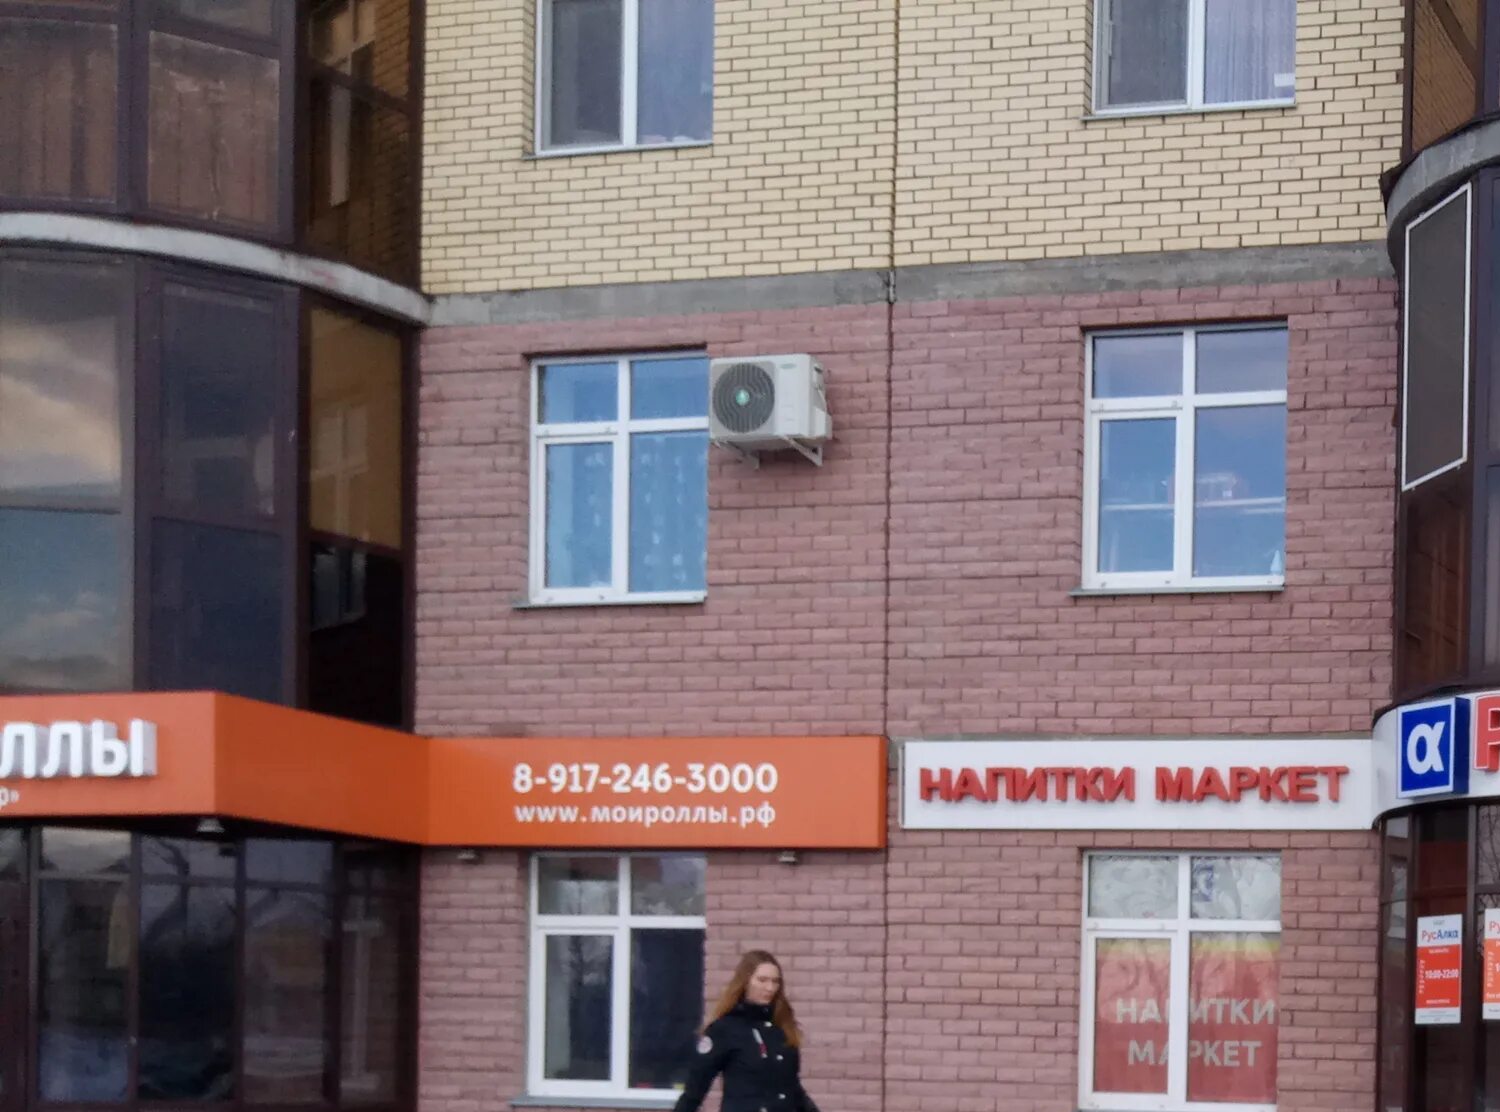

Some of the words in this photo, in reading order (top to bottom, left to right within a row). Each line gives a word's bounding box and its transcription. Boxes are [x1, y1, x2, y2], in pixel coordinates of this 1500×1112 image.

[512, 763, 779, 793] 8-917-246-3000
[919, 766, 1136, 804] НАПИТКИ
[1155, 766, 1350, 804] МАРКЕТ
[1116, 998, 1276, 1025] НАИТКИ
